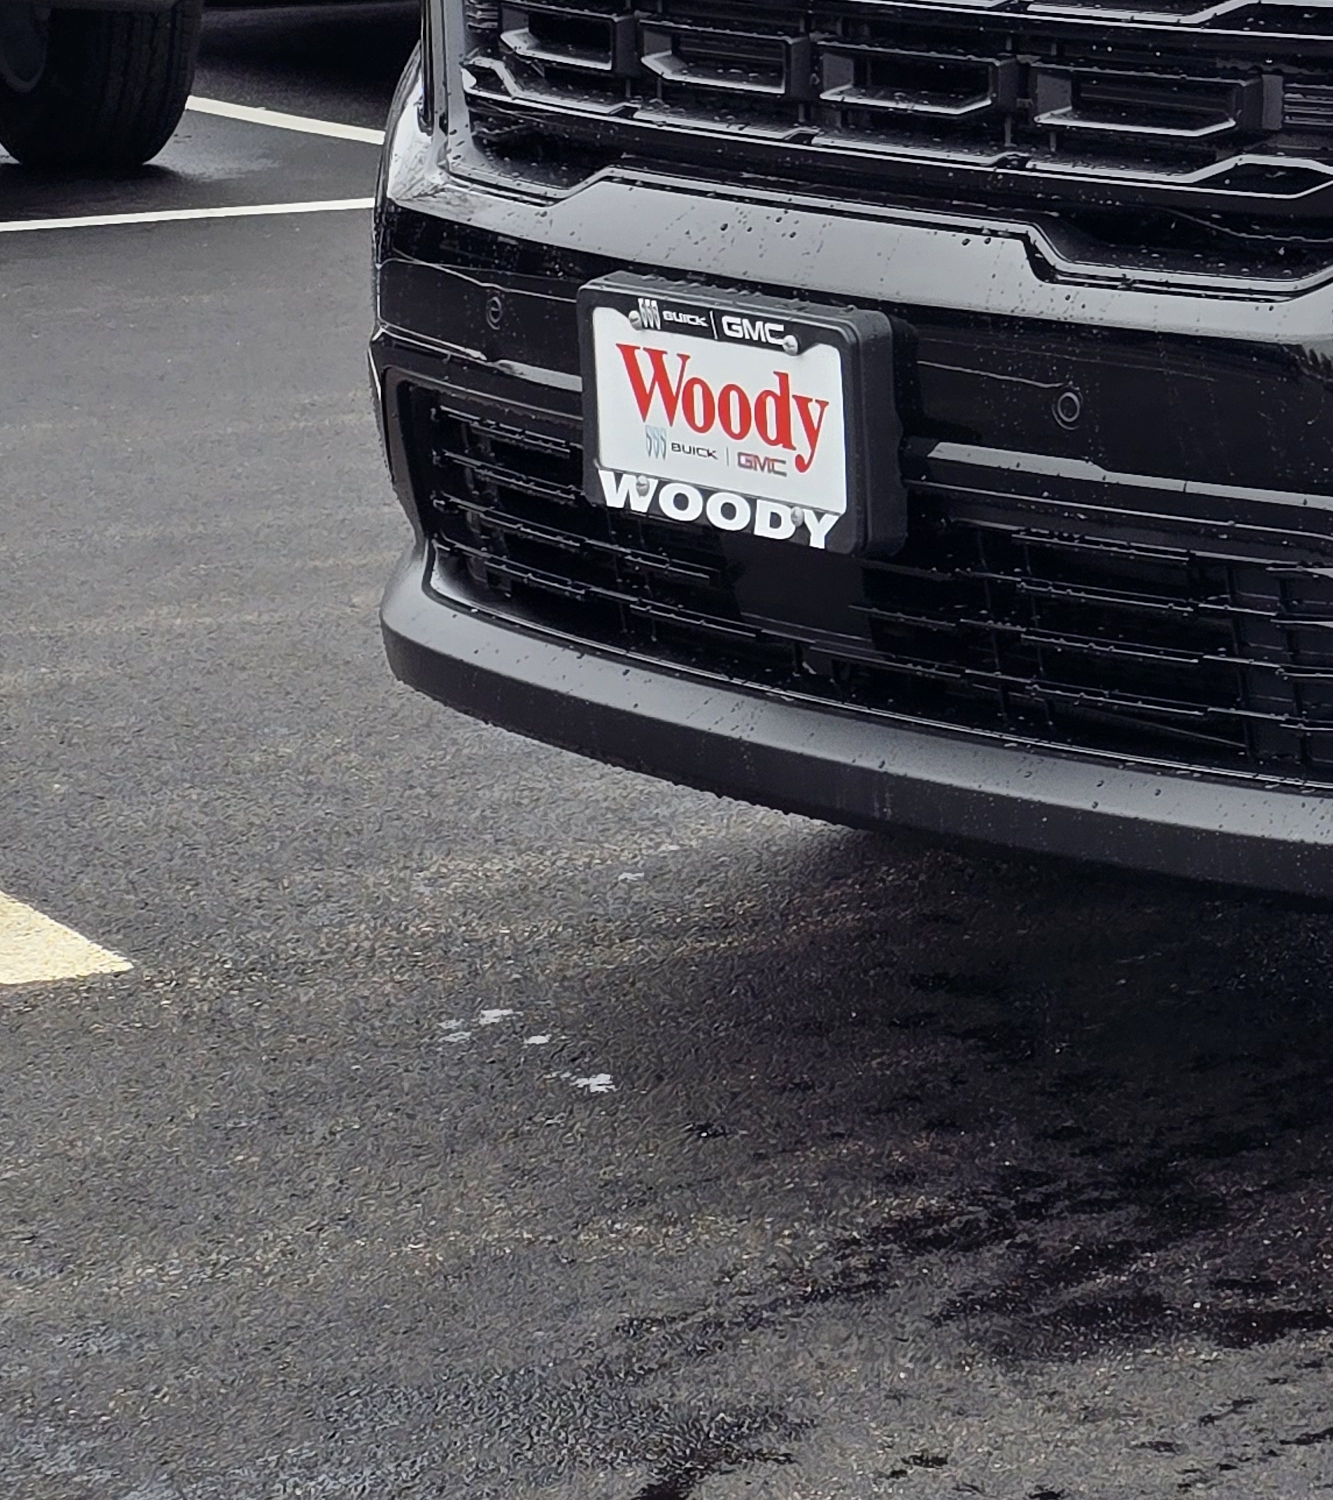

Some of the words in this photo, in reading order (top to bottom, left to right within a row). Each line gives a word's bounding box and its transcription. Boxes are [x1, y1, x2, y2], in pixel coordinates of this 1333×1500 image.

[662, 309, 708, 328] BUICK
[722, 315, 786, 344] GMC
[615, 343, 829, 473] Woody
[670, 442, 719, 460] BUICK
[737, 451, 788, 477] GMC
[598, 469, 840, 550] WOODY
